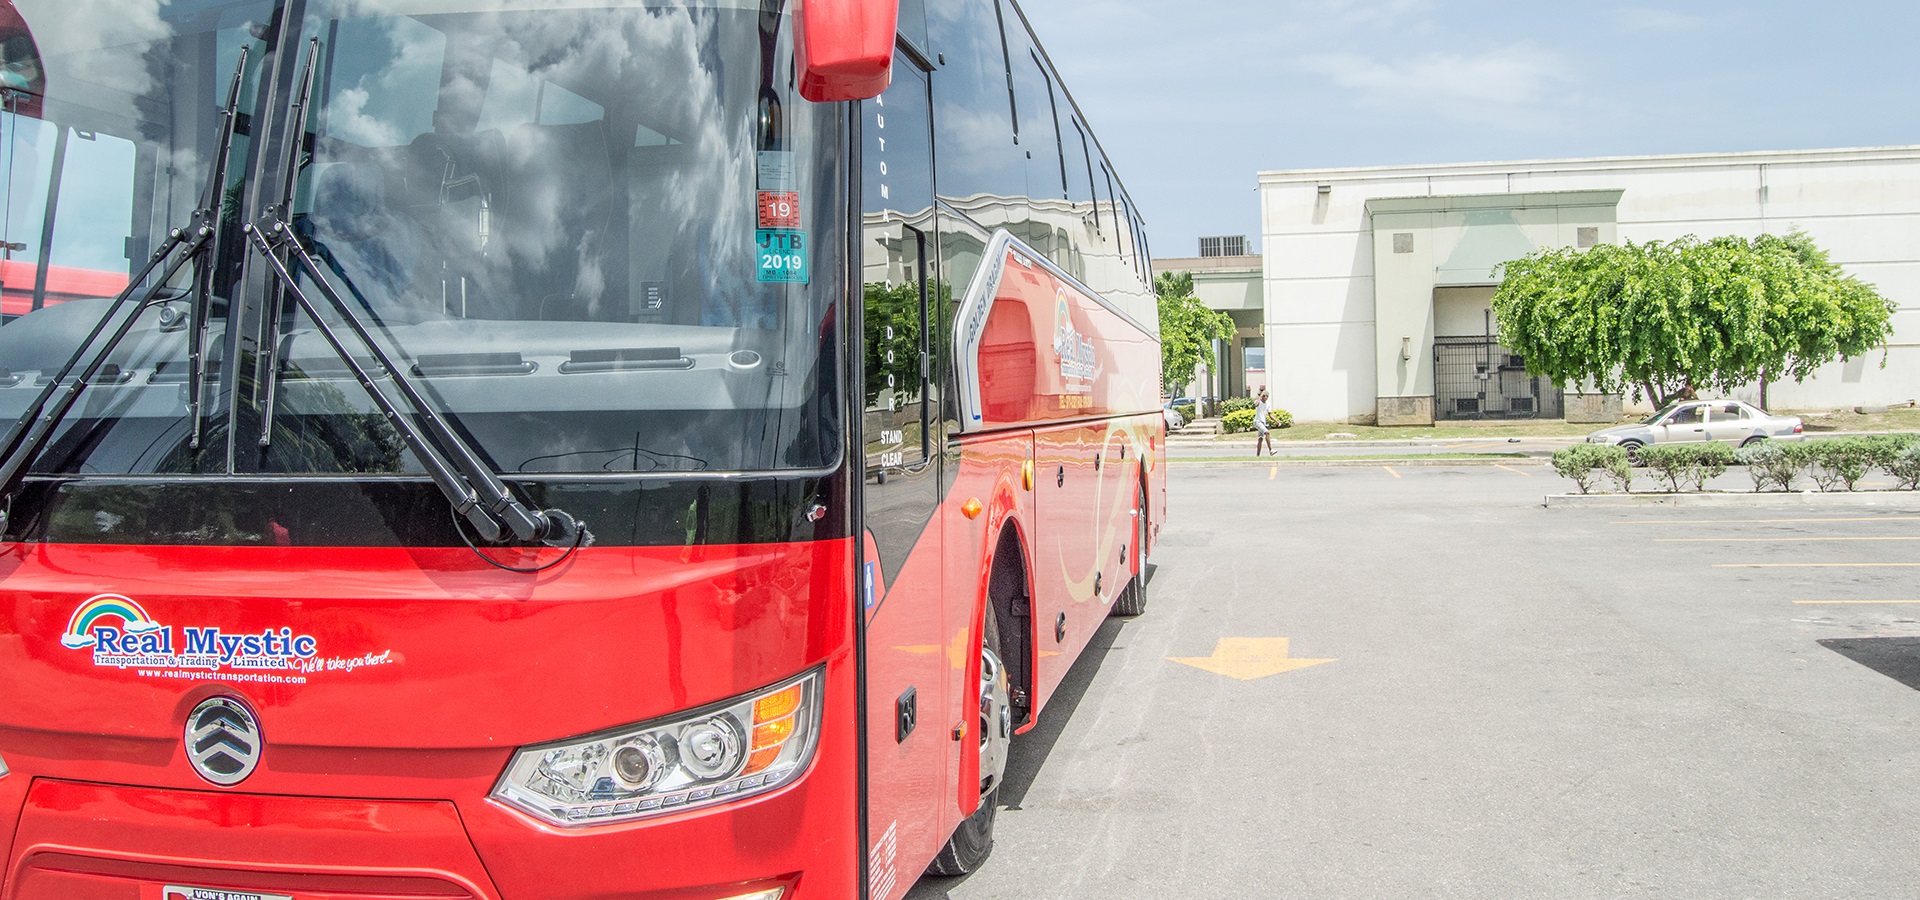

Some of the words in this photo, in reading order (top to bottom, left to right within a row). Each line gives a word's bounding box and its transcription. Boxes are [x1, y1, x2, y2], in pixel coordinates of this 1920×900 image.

[876, 93, 892, 293] AUTOMATIC
[768, 202, 791, 217] 19
[760, 233, 803, 249] JTB
[762, 254, 802, 270] 2019
[886, 326, 895, 412] DOOR
[880, 430, 903, 445] STAND
[881, 452, 903, 468] CLEAR
[94, 626, 173, 654] Real
[184, 627, 318, 663] Mystic
[94, 654, 166, 668] Transportation
[167, 656, 177, 667] &
[178, 656, 218, 669] Trading
[232, 656, 286, 668] Limited
[325, 655, 347, 671] take
[345, 657, 365, 673] you
[137, 668, 307, 685] www.realmystictransportation.com
